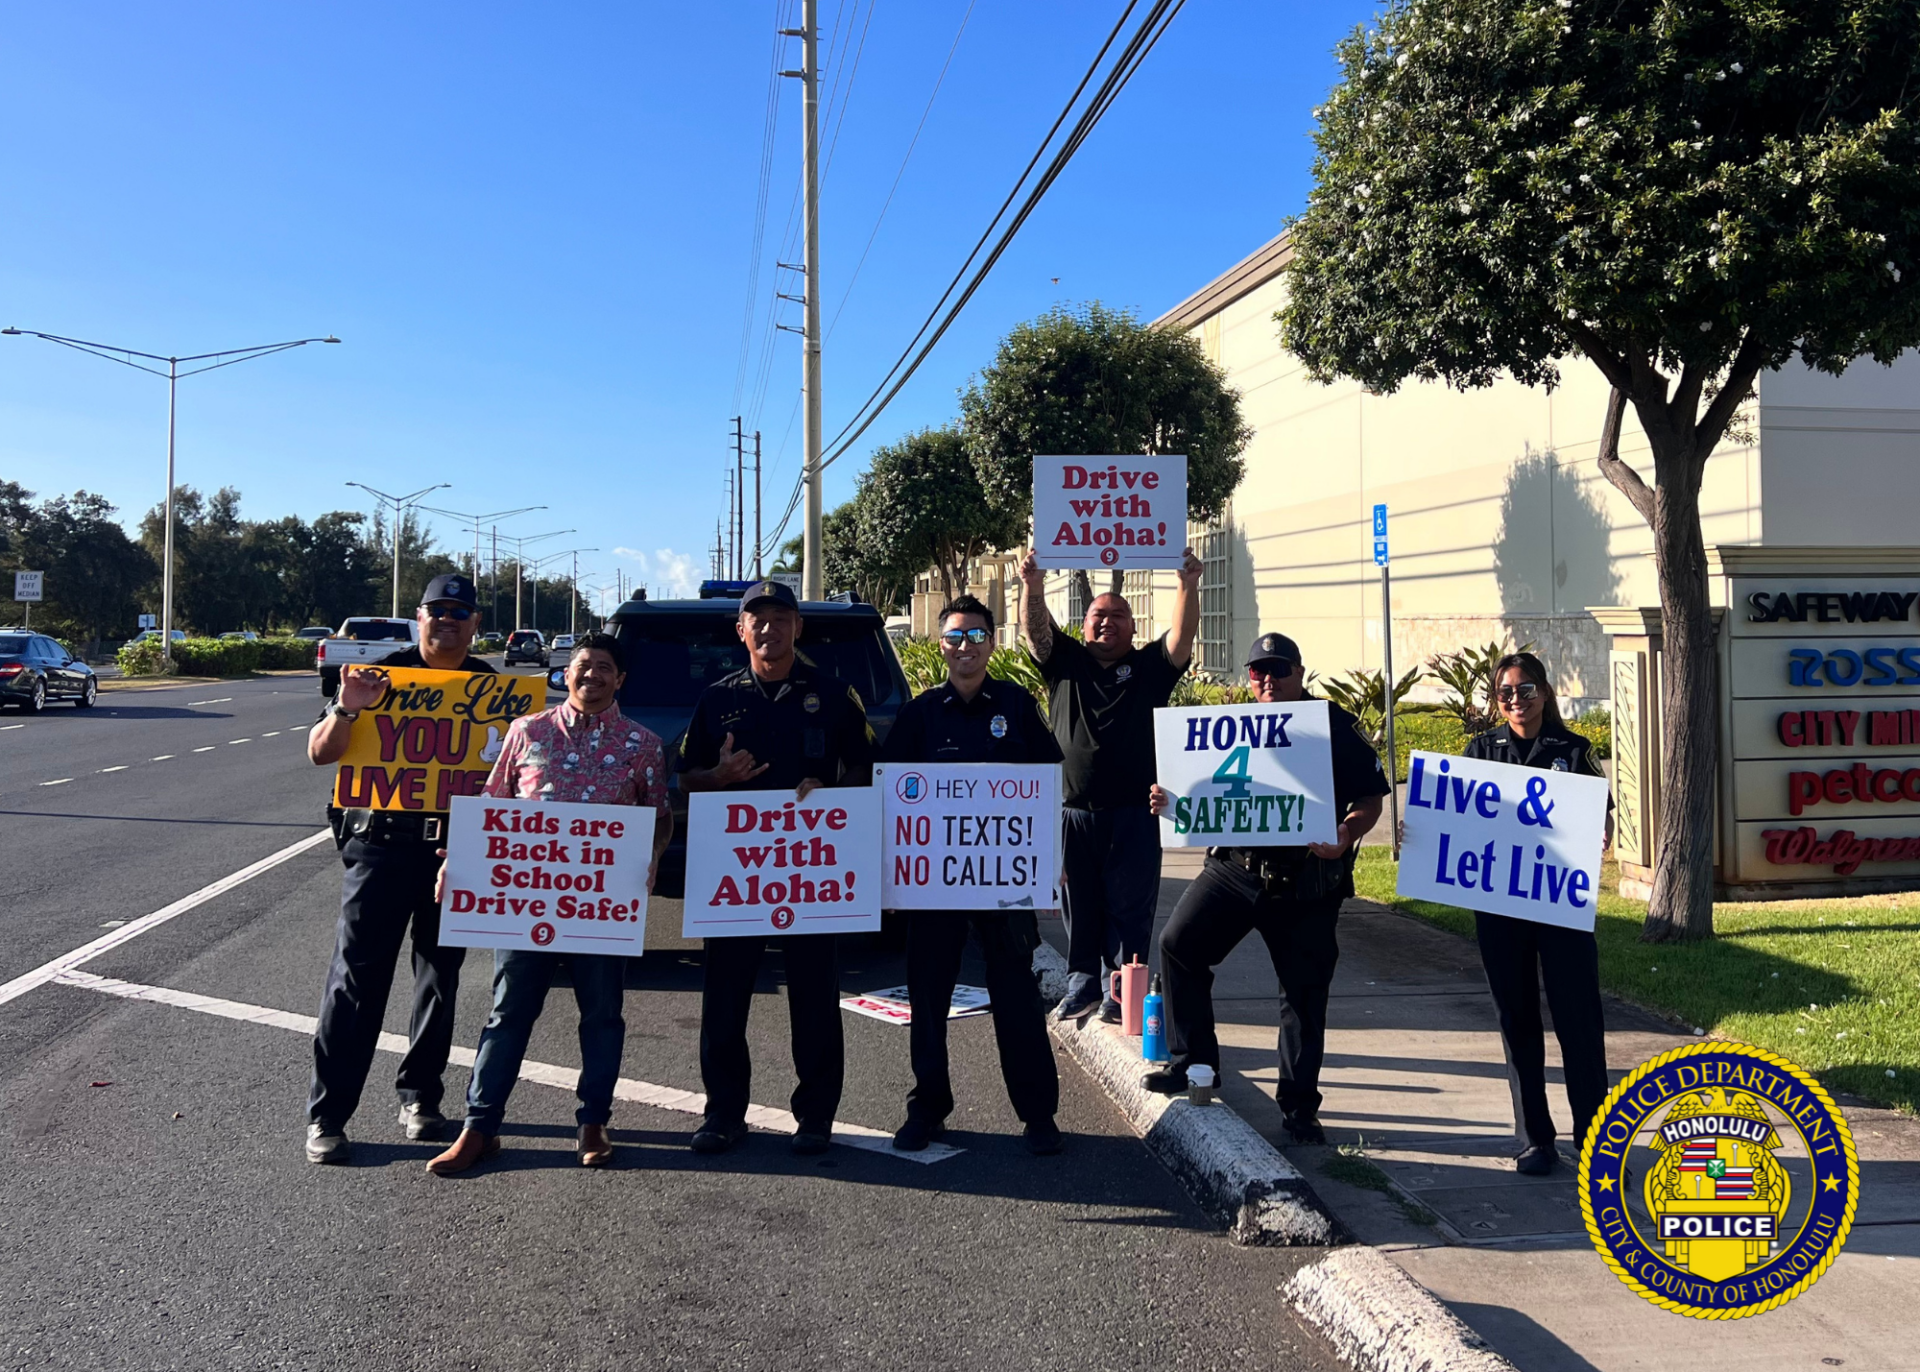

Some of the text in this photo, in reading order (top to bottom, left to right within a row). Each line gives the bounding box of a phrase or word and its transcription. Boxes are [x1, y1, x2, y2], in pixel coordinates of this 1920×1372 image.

[1062, 465, 1159, 490] Drive
[1069, 493, 1151, 518] with
[1051, 521, 1167, 546] Aloha!
[1748, 592, 1919, 623] SAFEWAY
[1789, 648, 1920, 686] ROSS
[452, 675, 533, 725] Like
[375, 714, 471, 765] YOU
[1184, 713, 1293, 751] HONK
[1777, 711, 1861, 747] CITY
[338, 765, 430, 810] LIVE
[936, 779, 1040, 799] HEY YOU!
[1211, 746, 1253, 799] 4
[1789, 762, 1920, 816] petco
[1408, 757, 1555, 829] Live &
[482, 808, 625, 839] Kids are
[724, 802, 848, 833] Drive
[895, 815, 1033, 846] NO TEXTS!
[1174, 794, 1305, 834] SAFETY!
[485, 836, 615, 866] Back in
[732, 836, 838, 869] with
[490, 864, 605, 893] School
[894, 855, 1038, 886] NO CALLS!
[1435, 832, 1590, 909] Let Live
[708, 871, 856, 906] Aloha!
[449, 889, 640, 923] Drive Safe!
